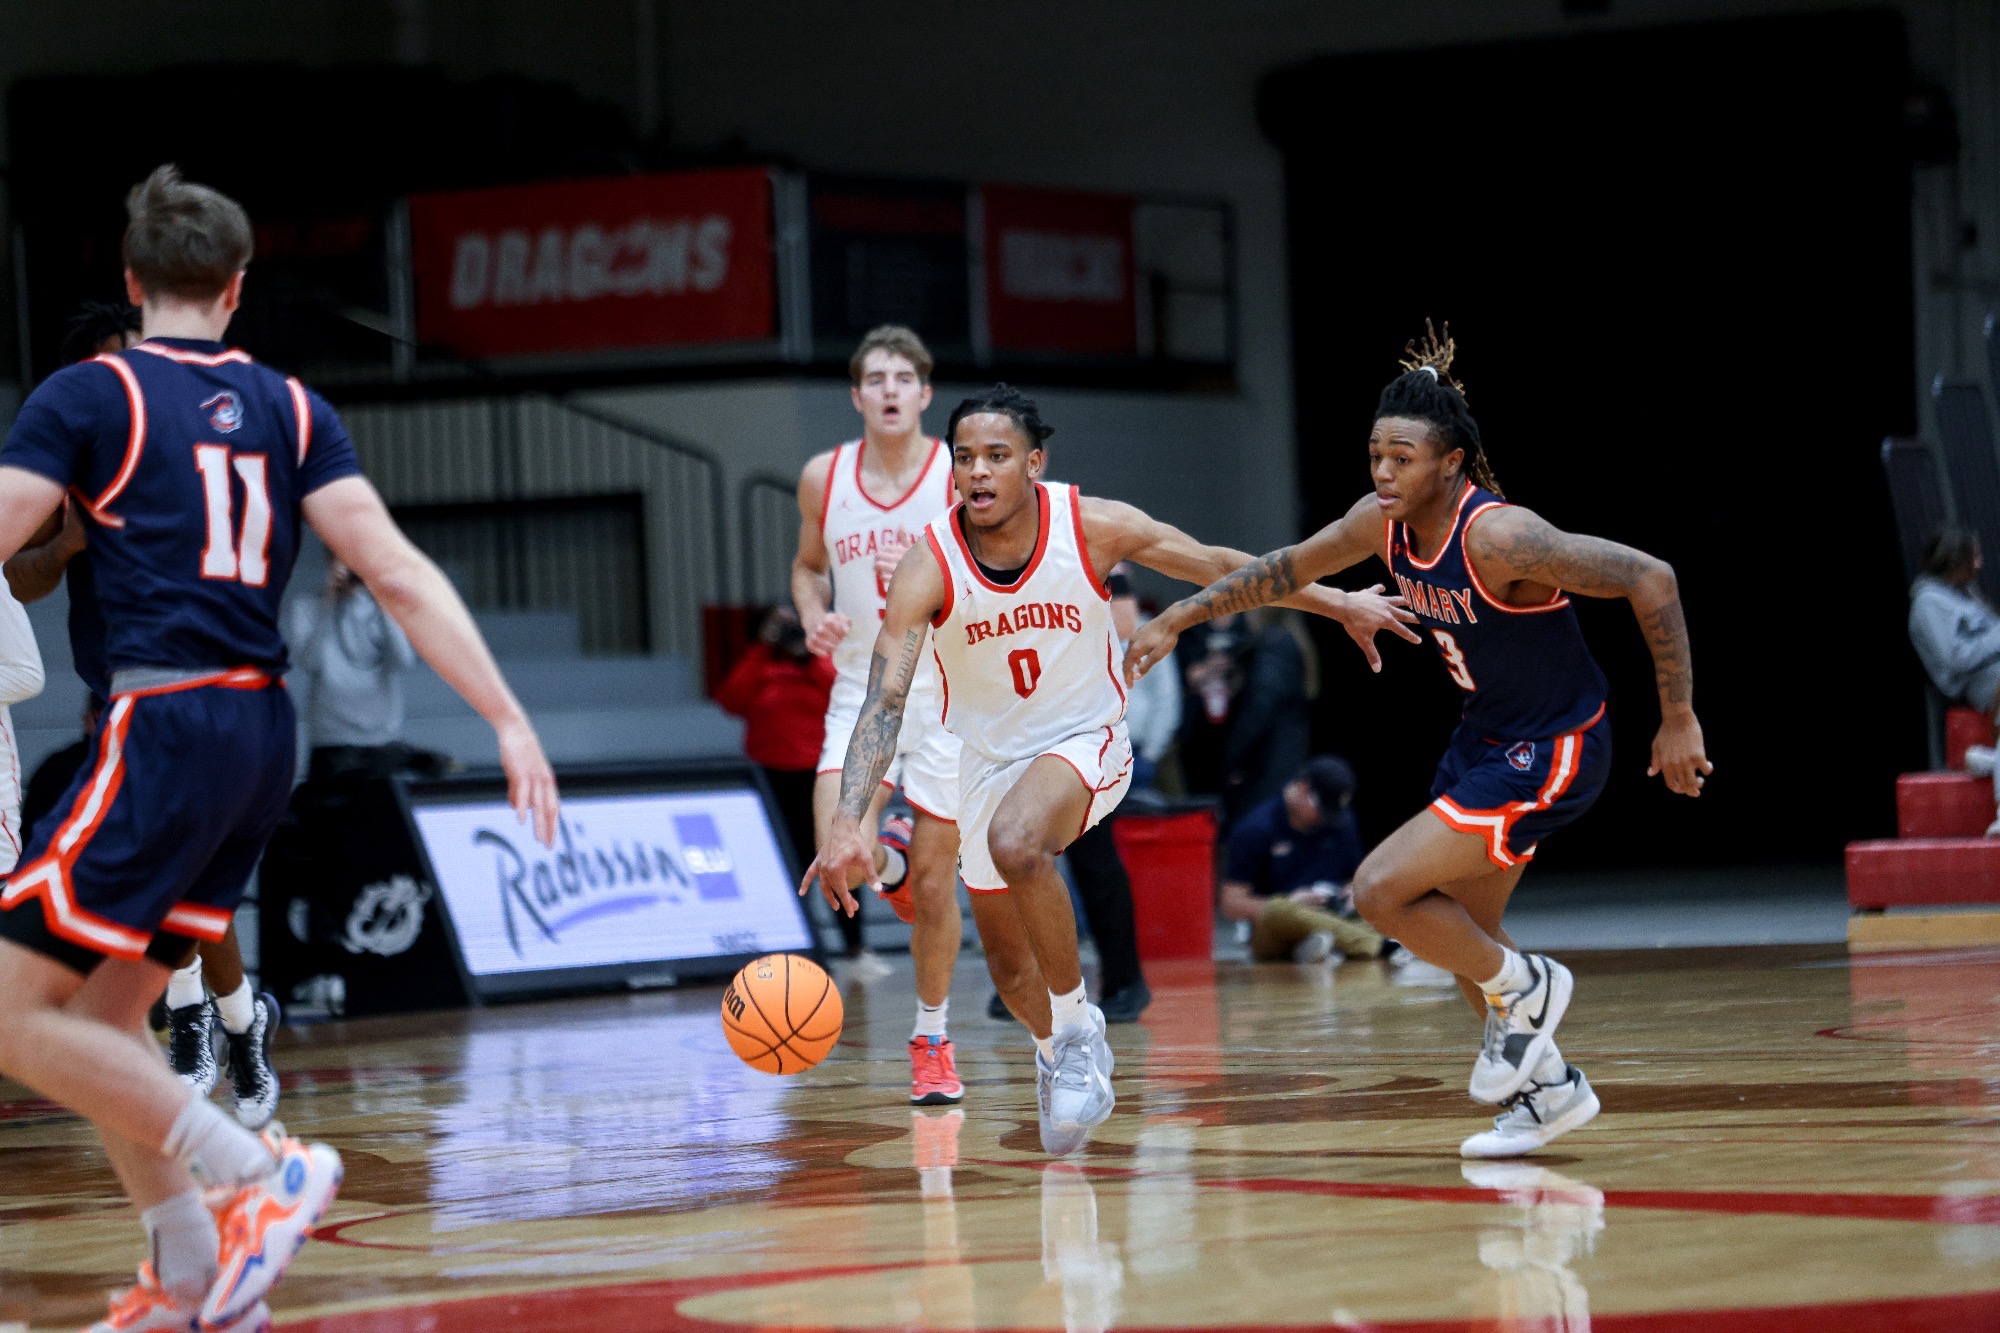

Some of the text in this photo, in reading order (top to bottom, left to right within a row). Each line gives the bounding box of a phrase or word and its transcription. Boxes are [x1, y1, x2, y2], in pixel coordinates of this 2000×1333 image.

[193, 444, 273, 588] 11
[965, 602, 1082, 645] DRAGONS
[1007, 648, 1042, 700] 0
[1431, 628, 1477, 692] 3
